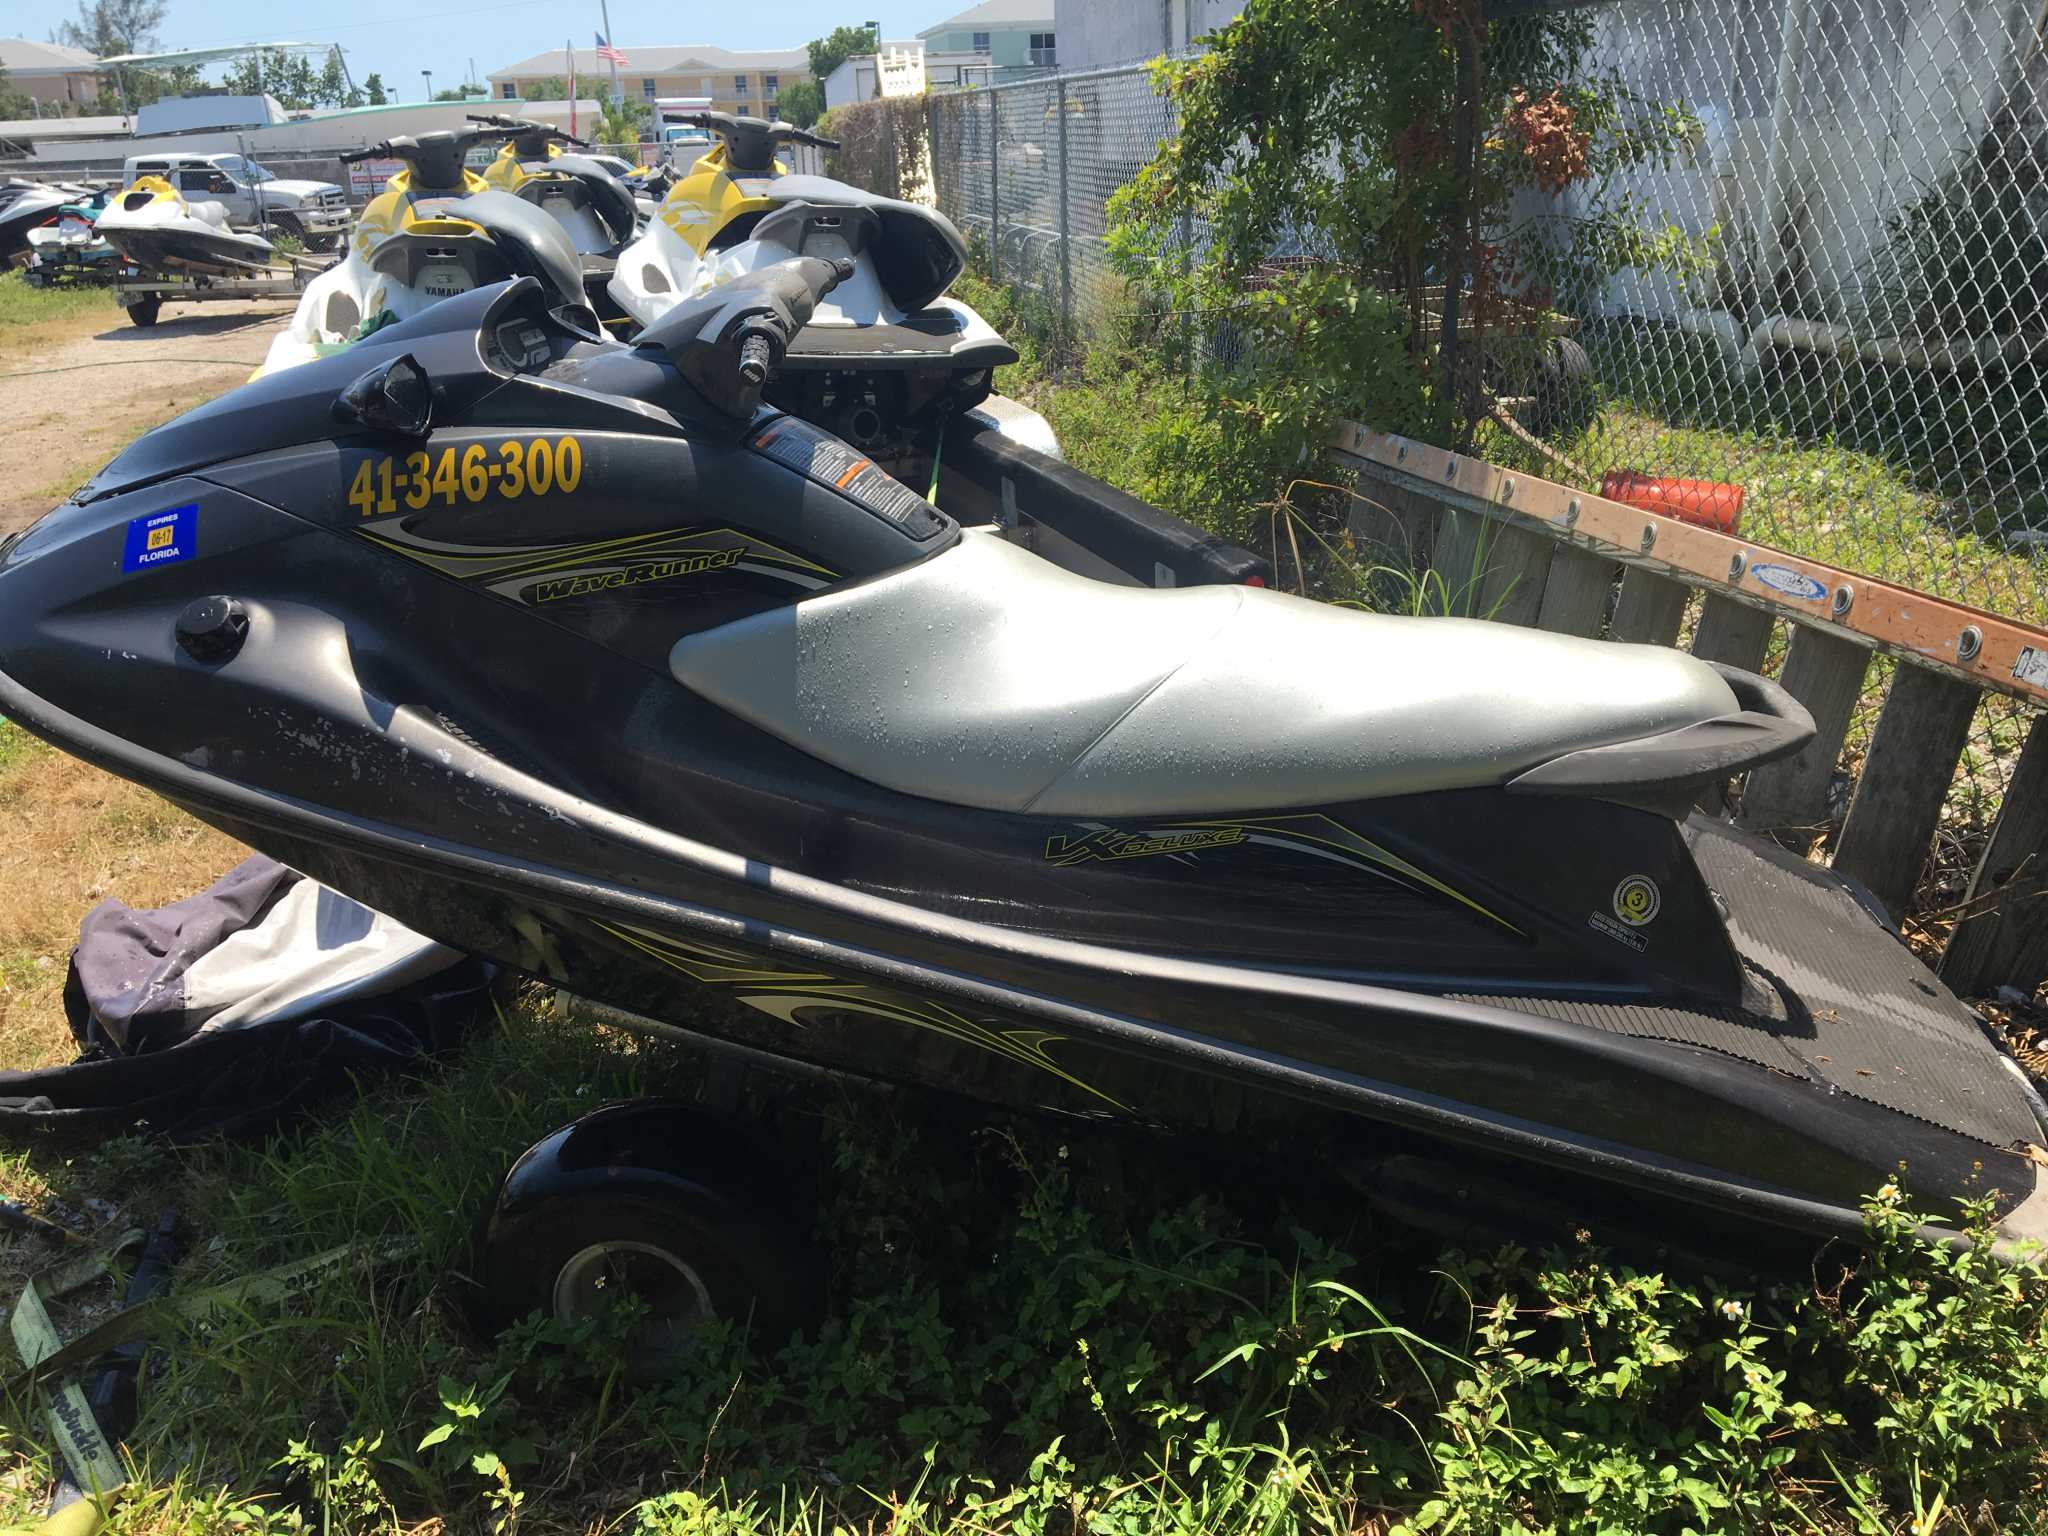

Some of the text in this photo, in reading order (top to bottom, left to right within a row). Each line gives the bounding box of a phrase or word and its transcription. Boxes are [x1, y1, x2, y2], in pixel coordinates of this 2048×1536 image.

[425, 286, 467, 297] YAMAH
[348, 435, 582, 516] 41-346-300
[147, 513, 178, 527] EXPIRES
[150, 528, 172, 546] 06-17
[139, 547, 180, 563] FLORIDA
[536, 547, 746, 602] WaveRunner
[1631, 892, 1643, 907] 3
